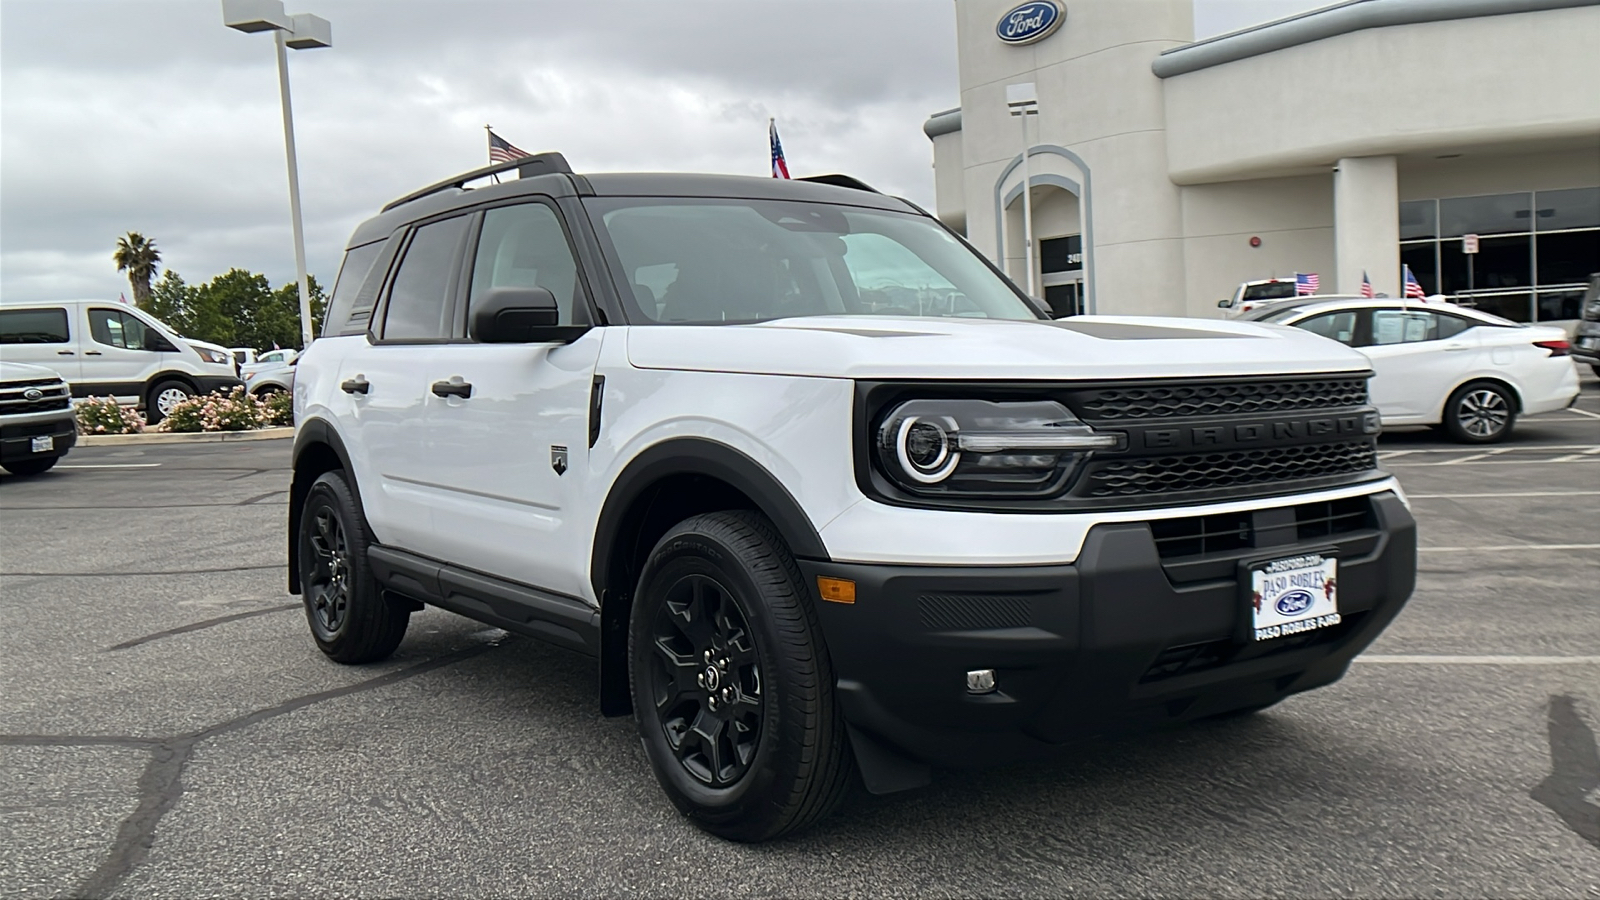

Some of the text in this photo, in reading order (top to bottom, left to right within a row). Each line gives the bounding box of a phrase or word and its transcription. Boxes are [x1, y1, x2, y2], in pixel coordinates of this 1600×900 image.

[1006, 7, 1045, 36] Ford
[1143, 416, 1358, 448] BRONCO
[1263, 570, 1325, 600] PASO ROBLES
[1255, 613, 1342, 641] PASO ROBLES FORD
